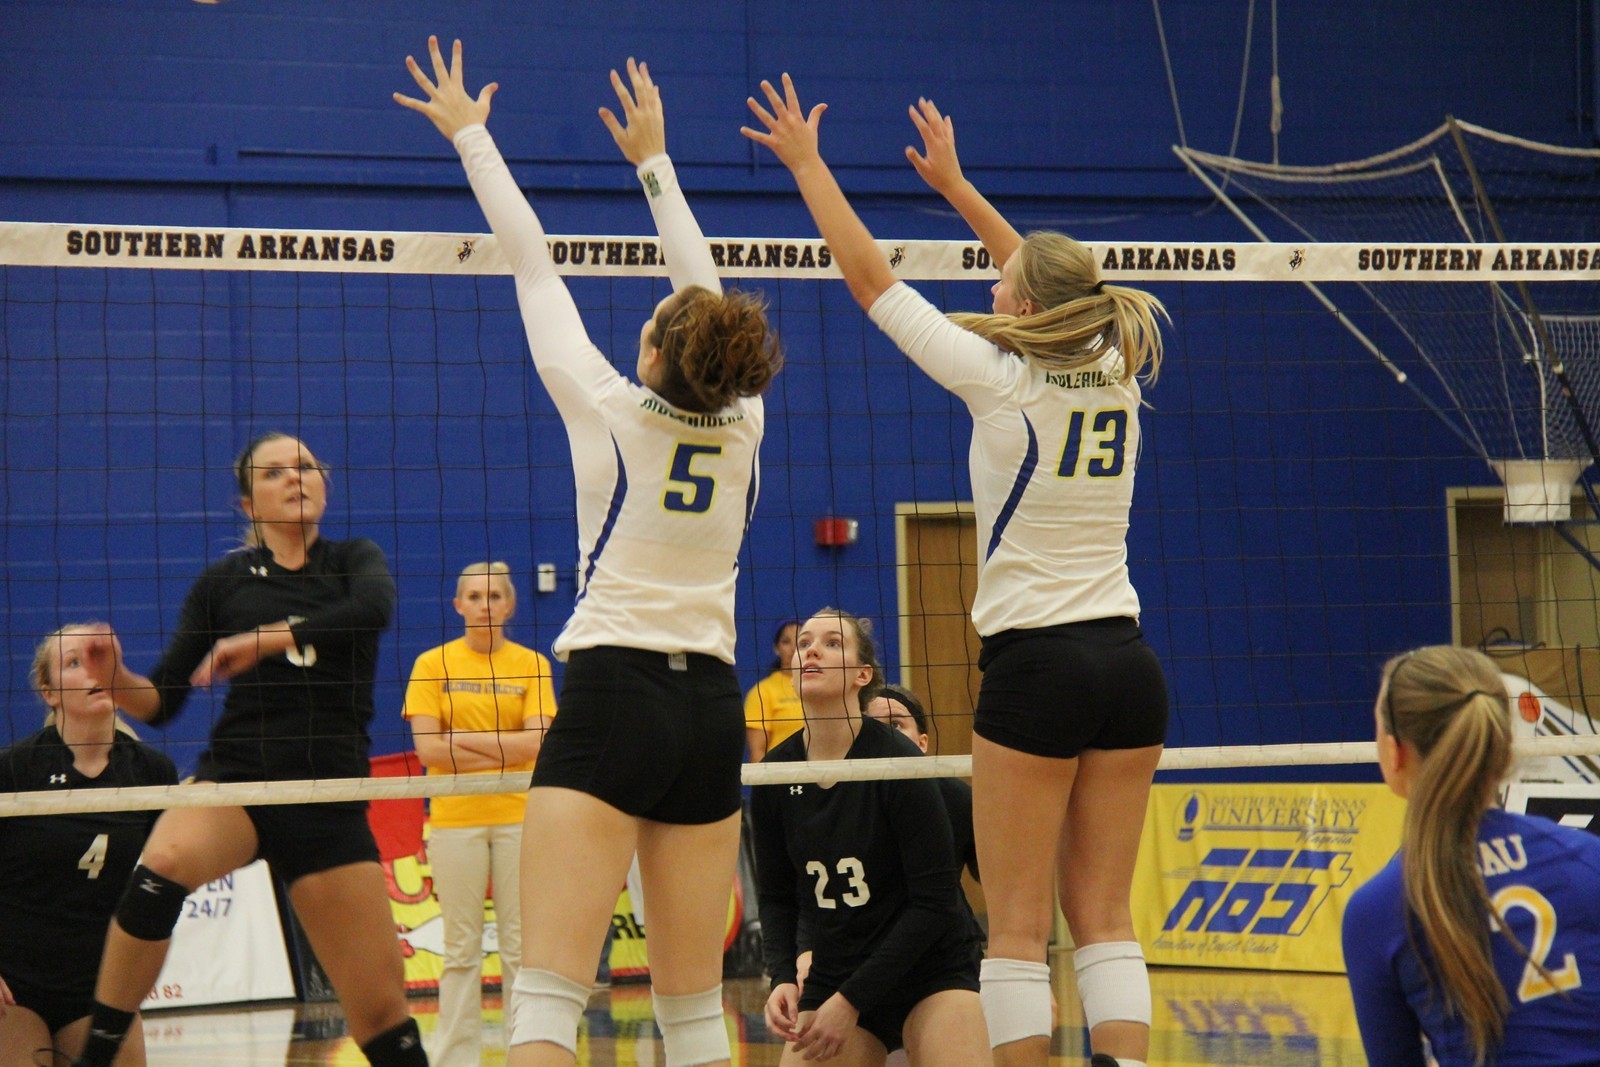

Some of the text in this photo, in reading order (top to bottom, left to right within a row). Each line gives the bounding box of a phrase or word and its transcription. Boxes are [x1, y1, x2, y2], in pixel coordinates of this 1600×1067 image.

[67, 230, 395, 262] SOUTHERN ARKANSAS
[547, 240, 832, 268] OUTHER RKANSAS
[1102, 247, 1236, 270] ARKANSAS
[1358, 248, 1483, 271] SOUTHERN
[1055, 407, 1129, 478] 13
[661, 440, 724, 514] 5
[1209, 807, 1363, 827] UNIVERSITY
[77, 833, 109, 880] 4
[1477, 834, 1528, 877] AU
[805, 856, 871, 910] 23
[185, 898, 232, 918] 24/7
[1489, 884, 1582, 1003] 2
